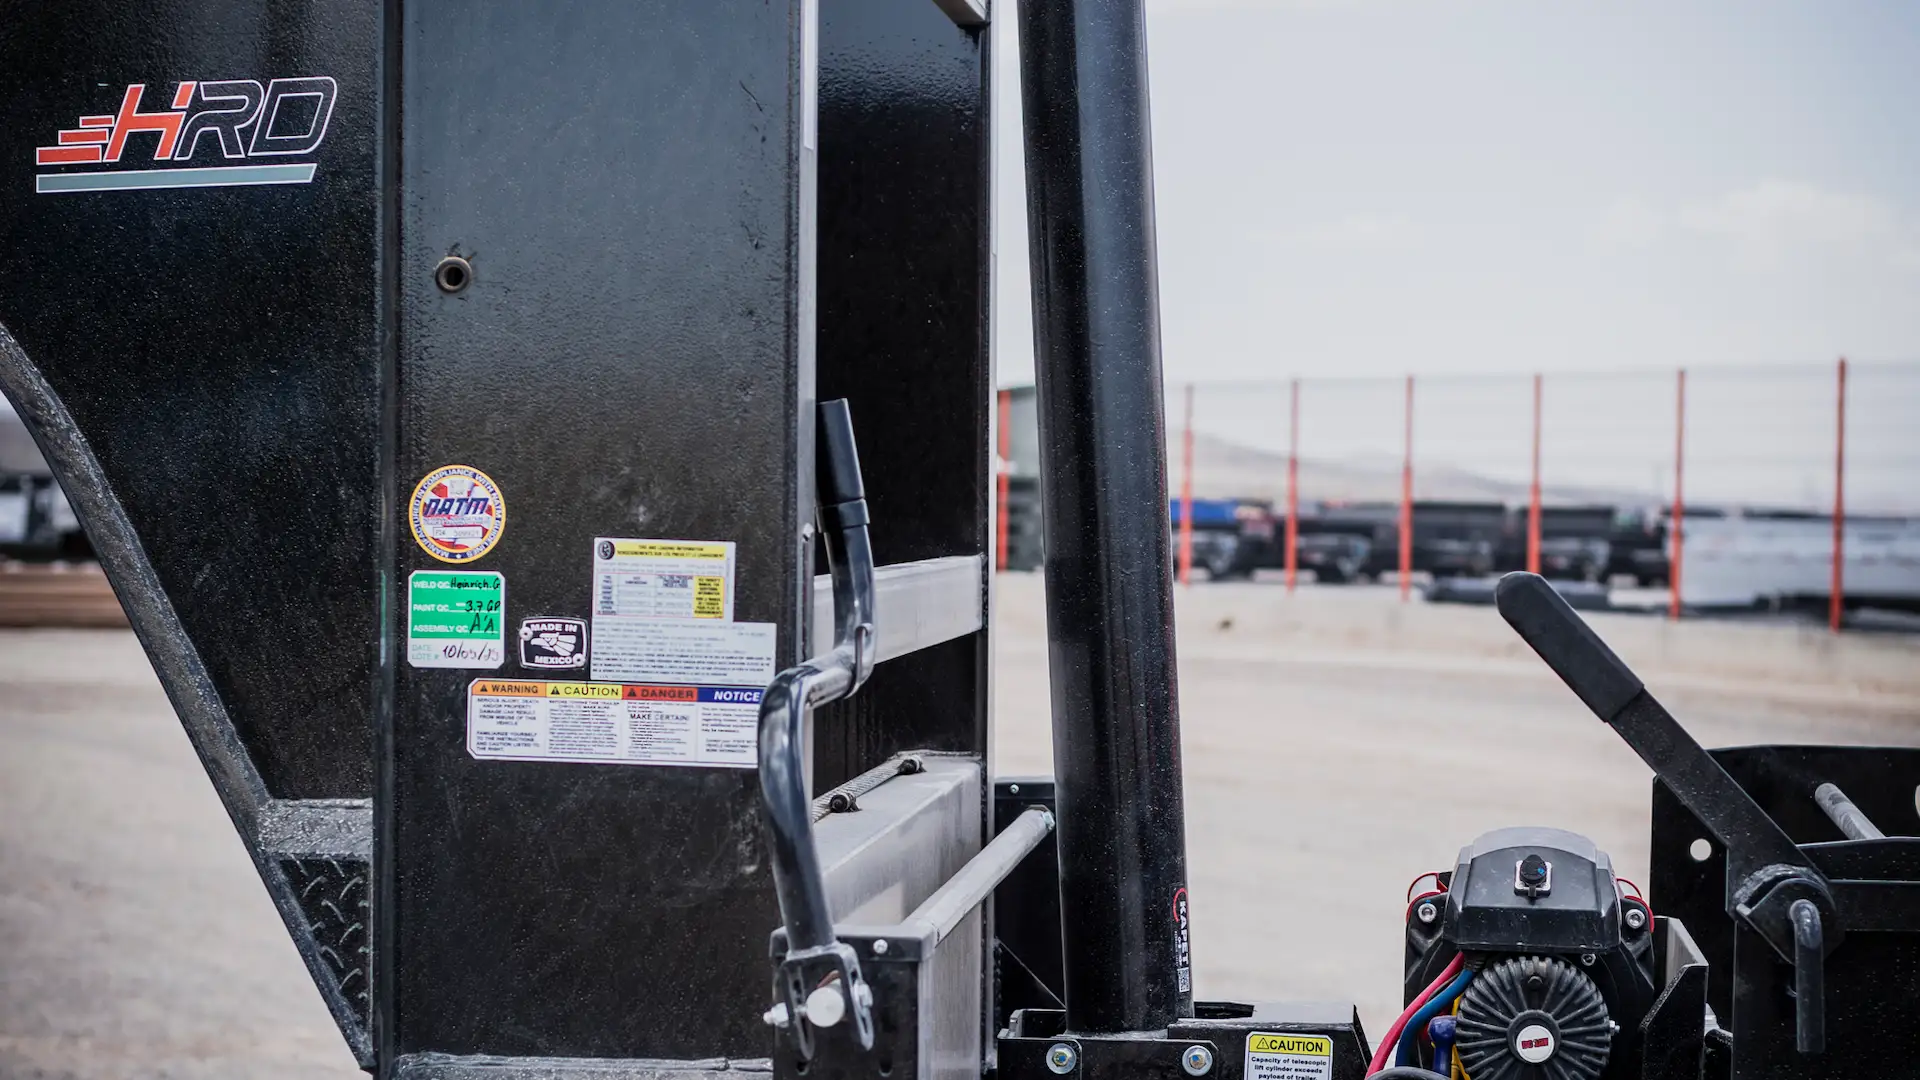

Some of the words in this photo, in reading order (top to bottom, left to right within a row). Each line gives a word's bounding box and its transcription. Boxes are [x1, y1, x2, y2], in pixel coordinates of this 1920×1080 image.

[102, 76, 338, 162] HRD
[423, 468, 475, 489] COMPLIANCE
[475, 474, 494, 493] WITH
[423, 497, 490, 516] NATM
[413, 500, 449, 558] MANUFACTURED
[466, 520, 502, 558] GUIDELINES
[413, 581, 437, 589] WELD
[413, 604, 436, 612] PAINT
[530, 623, 563, 632] MADE
[565, 624, 578, 632] IN
[534, 655, 573, 665] MEXICO
[491, 684, 539, 694] WARNING
[564, 686, 619, 696] CAUTION
[640, 688, 694, 698] DANGER
[714, 690, 761, 702] NOTICE
[1179, 900, 1189, 965] KAPET
[1269, 1039, 1323, 1052] CAUTION
[1251, 1056, 1281, 1064] Capacity
[1291, 1058, 1327, 1067] telescopic
[1265, 1065, 1293, 1073] cylinder
